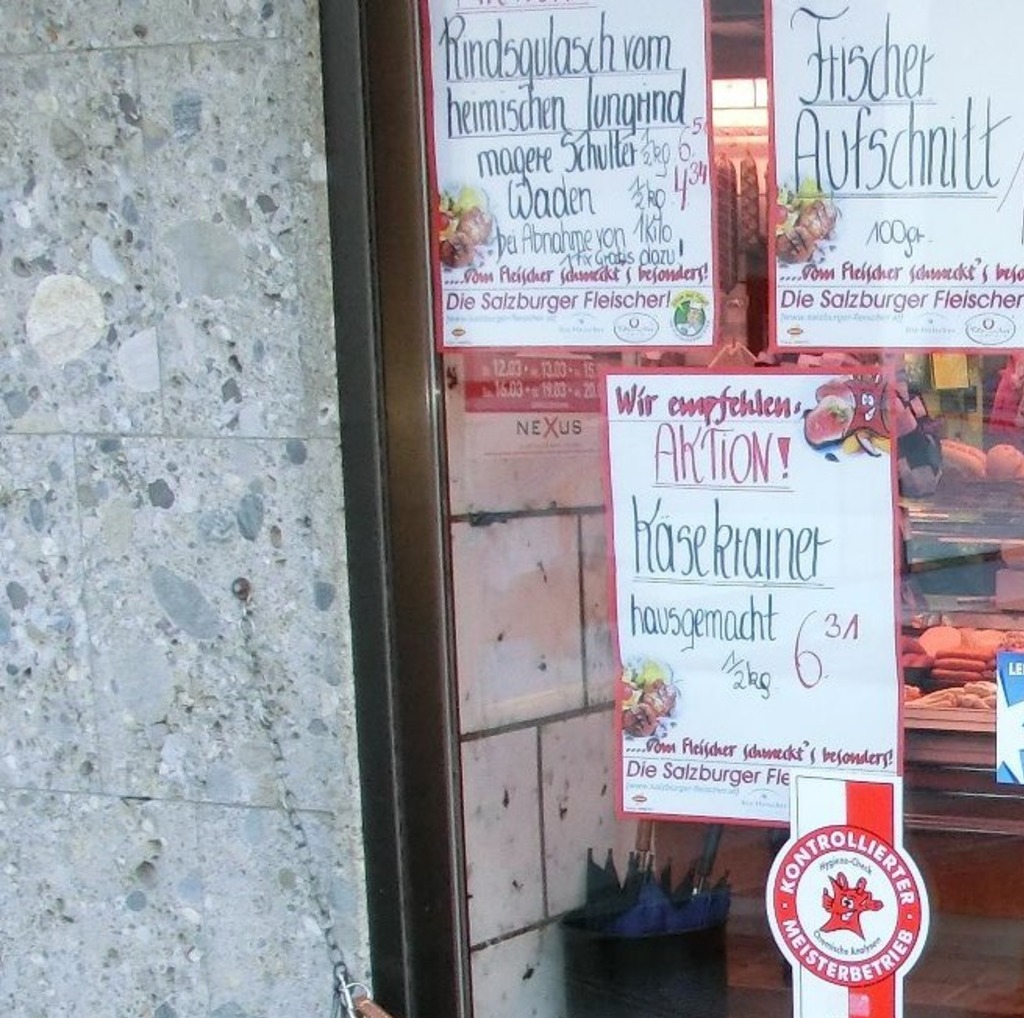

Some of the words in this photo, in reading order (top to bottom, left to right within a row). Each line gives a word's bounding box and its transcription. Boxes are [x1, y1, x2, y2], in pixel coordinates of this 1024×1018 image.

[439, 11, 616, 90] Rindsgulasch
[623, 35, 672, 71] vom
[790, 7, 935, 105] Frischer
[447, 87, 571, 138] heimischen
[478, 146, 552, 187] magere
[561, 129, 637, 172] Schulter
[795, 97, 1012, 192] Aufschnitt
[508, 174, 597, 220] Waden
[523, 221, 593, 254] Abnahme
[596, 226, 626, 254] von
[499, 265, 554, 285] Fleischer
[638, 263, 709, 286] besonders!
[841, 261, 901, 283] Fleischer
[446, 292, 476, 311] Die
[480, 291, 577, 314] Salzburger
[583, 290, 671, 310] Fleischer!
[781, 290, 815, 308] Die
[819, 290, 928, 313] Salzburger
[615, 383, 658, 417] Wir
[516, 416, 582, 439] NEXUS
[632, 495, 832, 581] Käsekrainer
[630, 593, 778, 652] hausgemacht
[626, 760, 657, 778] Die
[662, 761, 761, 786] Salzburger
[682, 737, 738, 759] Fleischer
[822, 746, 894, 769] besonders!
[780, 831, 914, 905] KONTROLLIERTER
[783, 919, 913, 982] MEISTERBETRIEB
